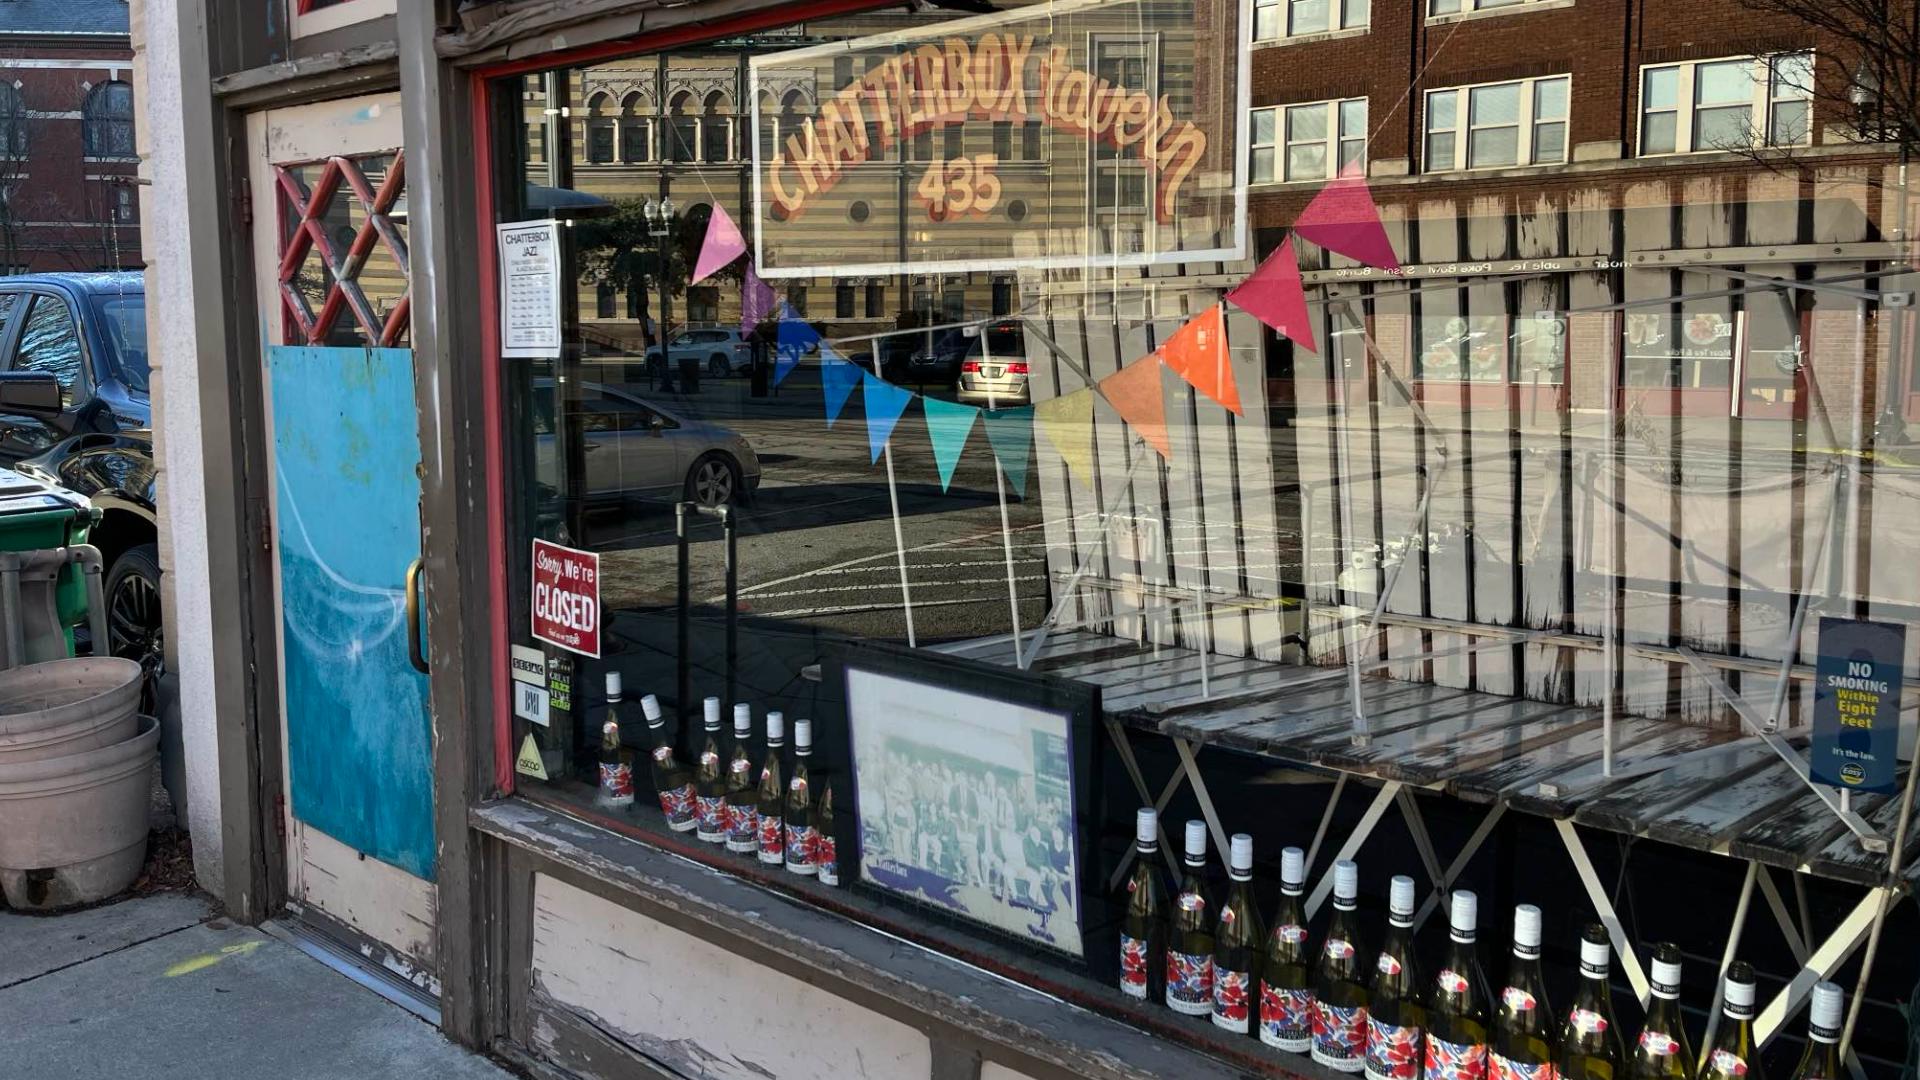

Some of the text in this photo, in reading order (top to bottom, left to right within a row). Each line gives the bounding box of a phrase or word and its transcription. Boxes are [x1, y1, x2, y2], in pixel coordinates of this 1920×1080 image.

[769, 33, 1036, 213] CHATTERBOX
[916, 153, 1002, 216] 435
[505, 232, 550, 245] CHATTERBOX
[522, 246, 538, 257] JAZZ
[535, 581, 595, 633] CLOSED
[1848, 662, 1873, 678] NO
[1827, 675, 1888, 694] SMOKING
[1837, 688, 1880, 703] Within
[1839, 701, 1877, 717] Eight
[1841, 714, 1872, 729] Feet
[1845, 750, 1860, 759] the
